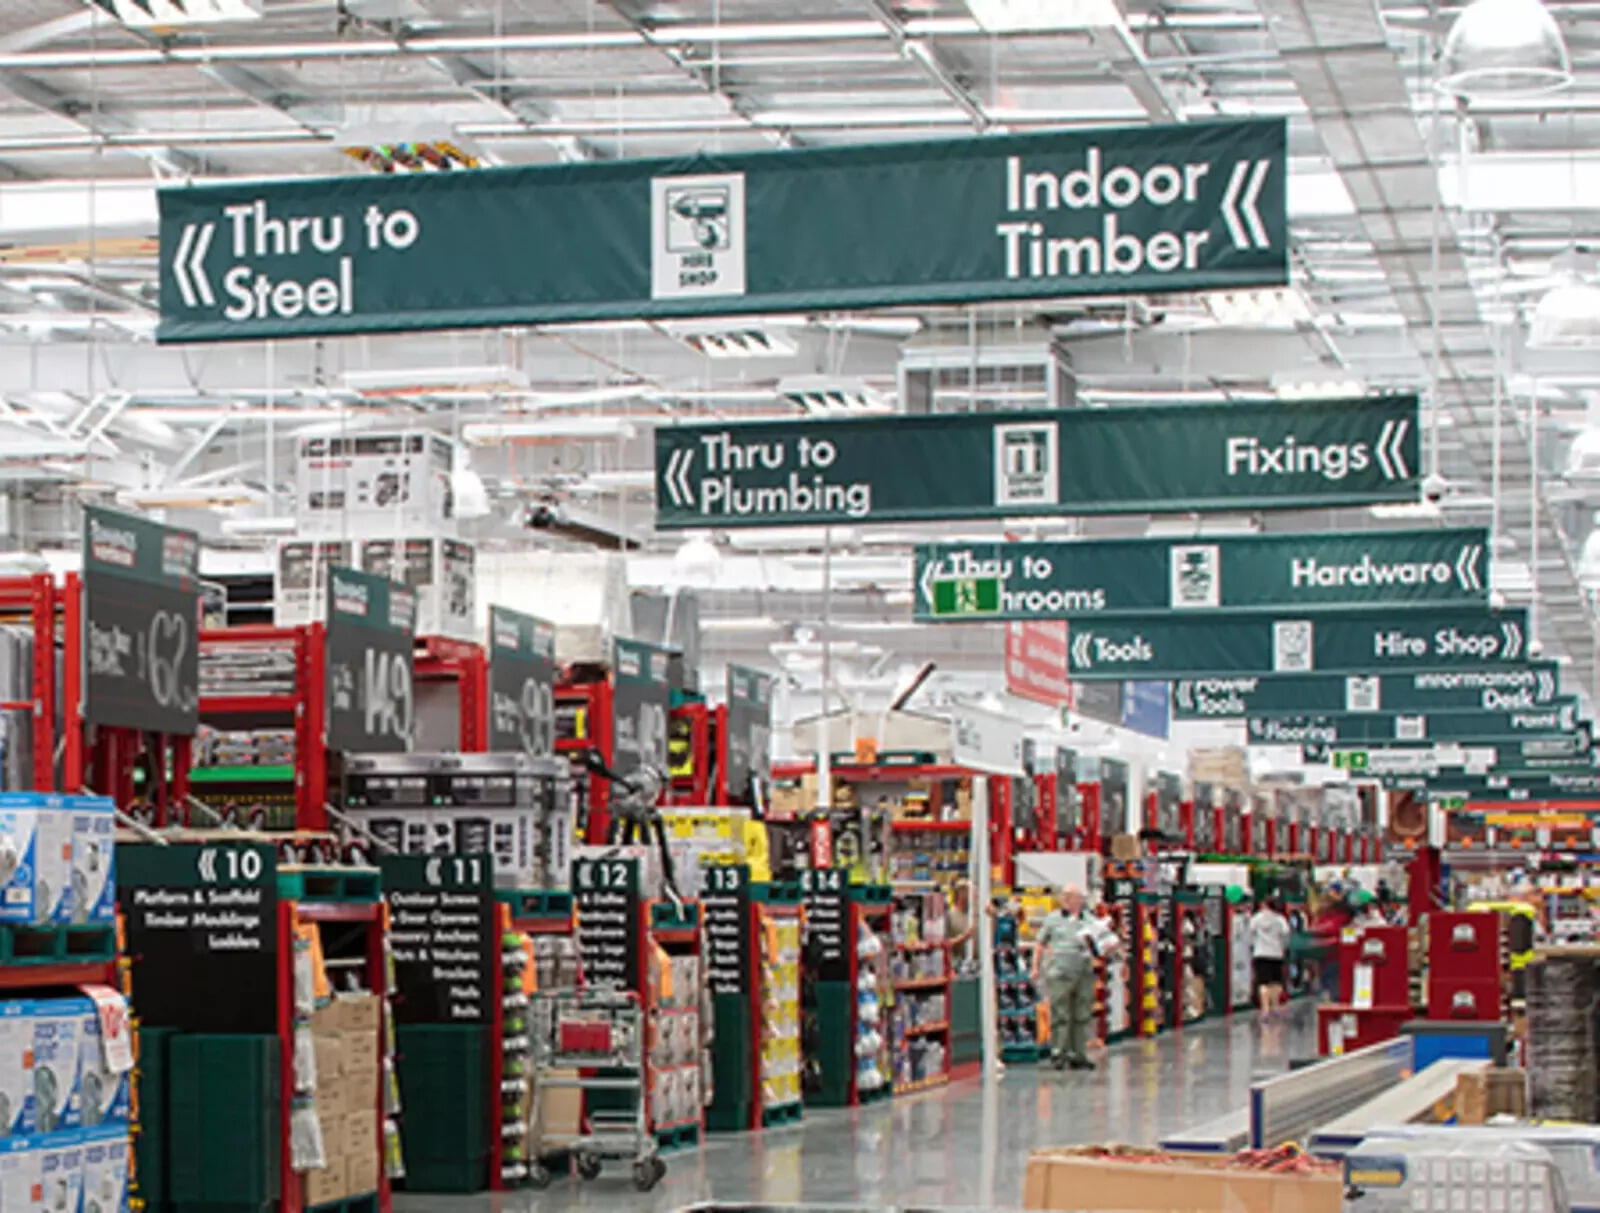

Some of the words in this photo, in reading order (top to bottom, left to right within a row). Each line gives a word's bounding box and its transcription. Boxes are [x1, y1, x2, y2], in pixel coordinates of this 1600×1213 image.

[1007, 148, 1209, 212] Indoor
[224, 200, 343, 257] Thru
[365, 206, 419, 249] to
[997, 213, 1209, 277] Timber
[224, 257, 353, 320] Steel
[701, 433, 784, 471] Thru
[798, 437, 836, 468] to
[1226, 436, 1368, 479] Fixings
[701, 472, 871, 518] Plumbing
[1022, 556, 1052, 579] to
[1291, 554, 1452, 588] Hardware
[1000, 588, 1106, 612] hrooms
[1094, 636, 1153, 661] Tools
[1374, 631, 1427, 657] Hire
[1434, 629, 1499, 658] Shop
[1483, 687, 1534, 710] Desk
[227, 849, 262, 880] 10
[454, 859, 480, 884] 11
[601, 864, 628, 886] 12
[715, 868, 739, 889] 13
[818, 871, 839, 890] 14
